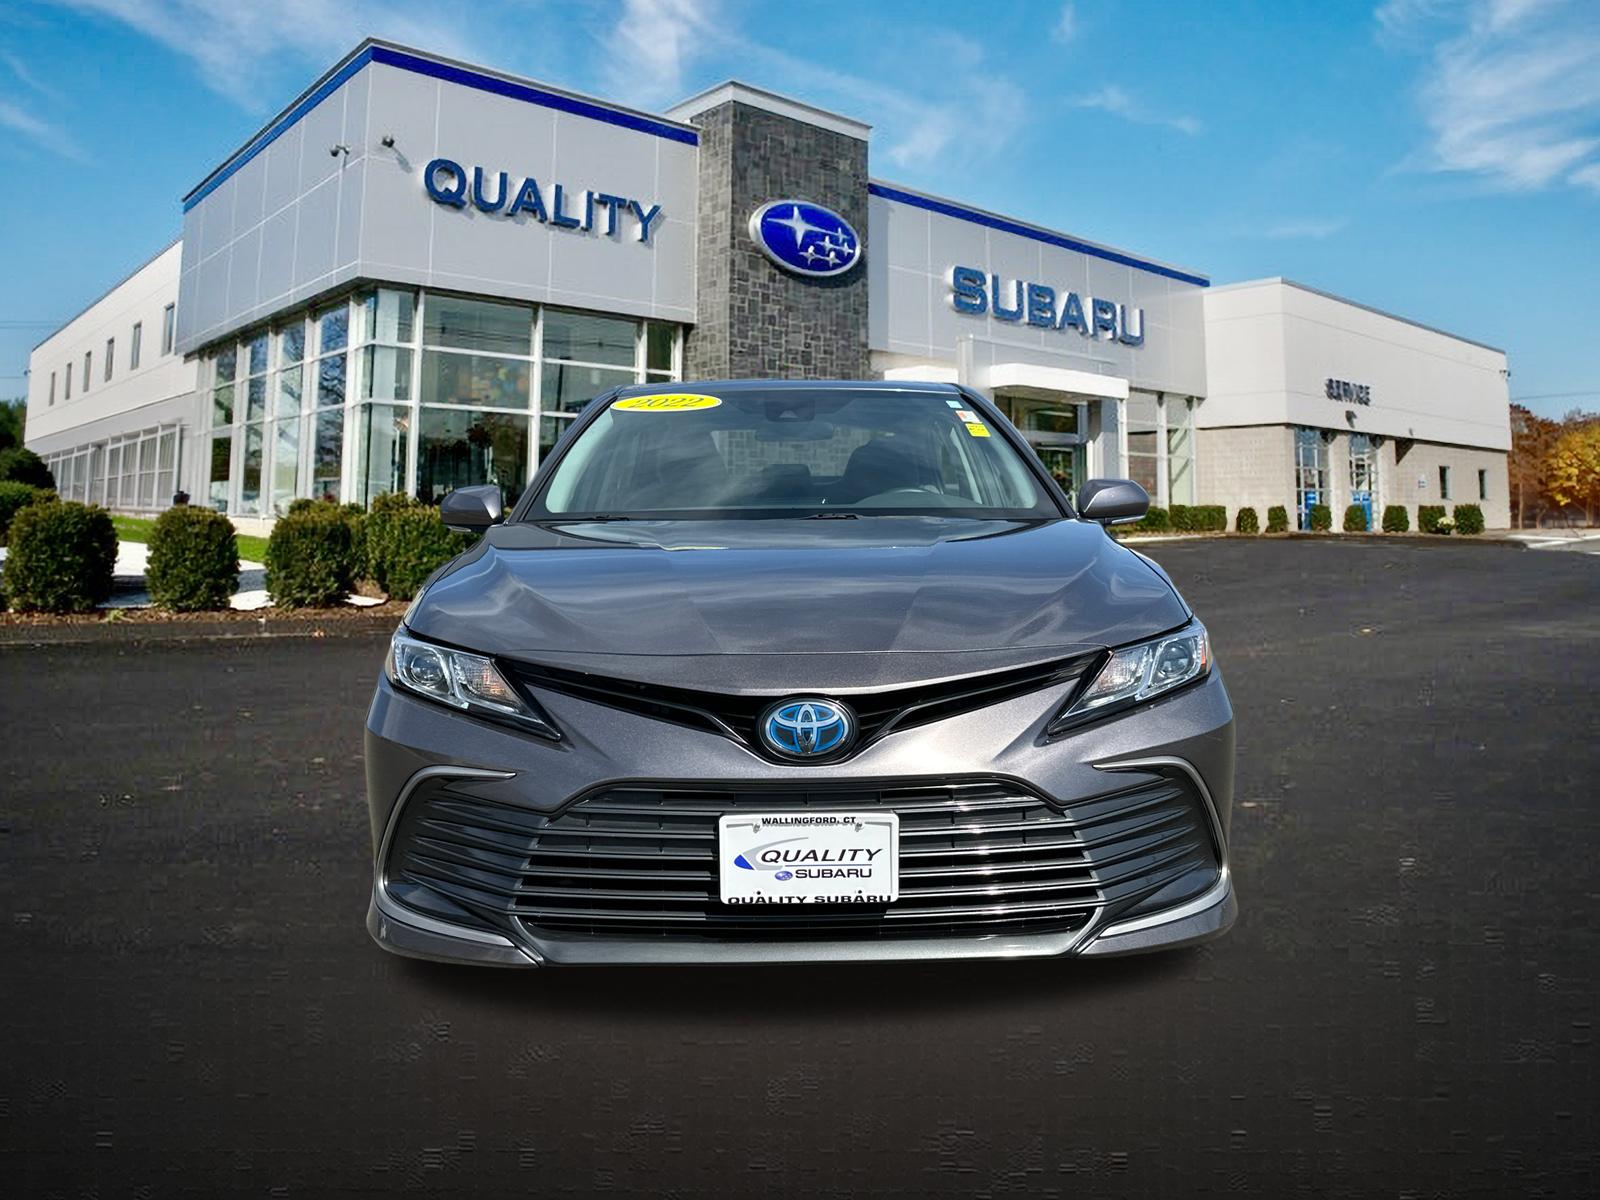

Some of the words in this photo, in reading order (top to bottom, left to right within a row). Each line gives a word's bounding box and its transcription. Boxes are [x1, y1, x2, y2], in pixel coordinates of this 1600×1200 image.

[424, 158, 661, 242] QUALITY
[951, 265, 1145, 346] SUBARU
[1324, 378, 1371, 406] SERVICE
[626, 397, 705, 409] 2022
[843, 816, 857, 824] CT
[761, 848, 883, 863] QUALITY
[795, 868, 873, 879] SUBARU
[727, 895, 807, 905] QUALITY
[814, 895, 892, 904] SUBARU
